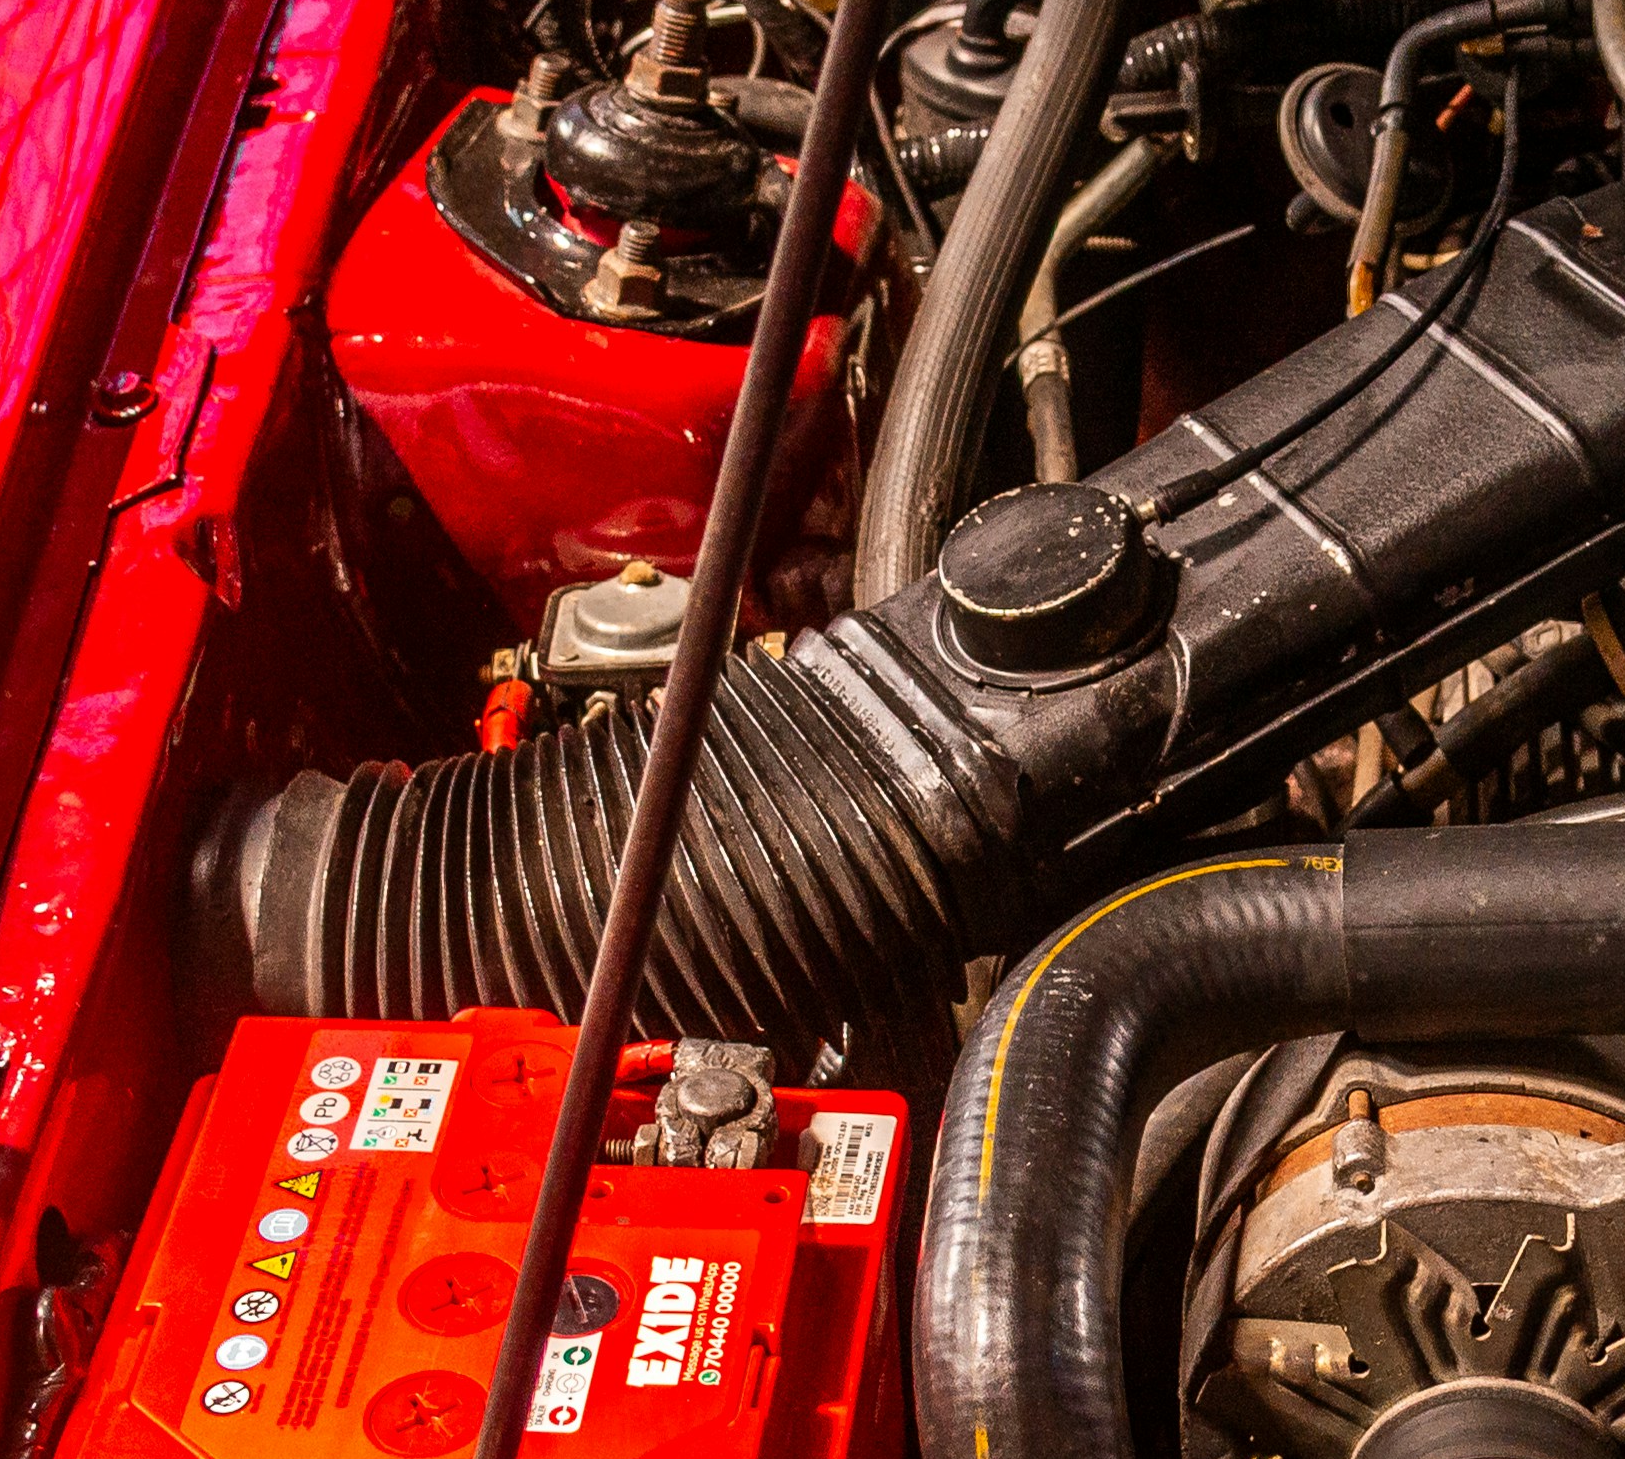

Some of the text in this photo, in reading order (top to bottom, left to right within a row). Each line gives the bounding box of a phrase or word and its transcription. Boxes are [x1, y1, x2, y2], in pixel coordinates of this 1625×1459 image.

[313, 1097, 338, 1118] Pb
[625, 1255, 705, 1388] EXIDE
[682, 1262, 720, 1382] Message us on WhatsApp
[703, 1261, 742, 1369] 70440 00000
